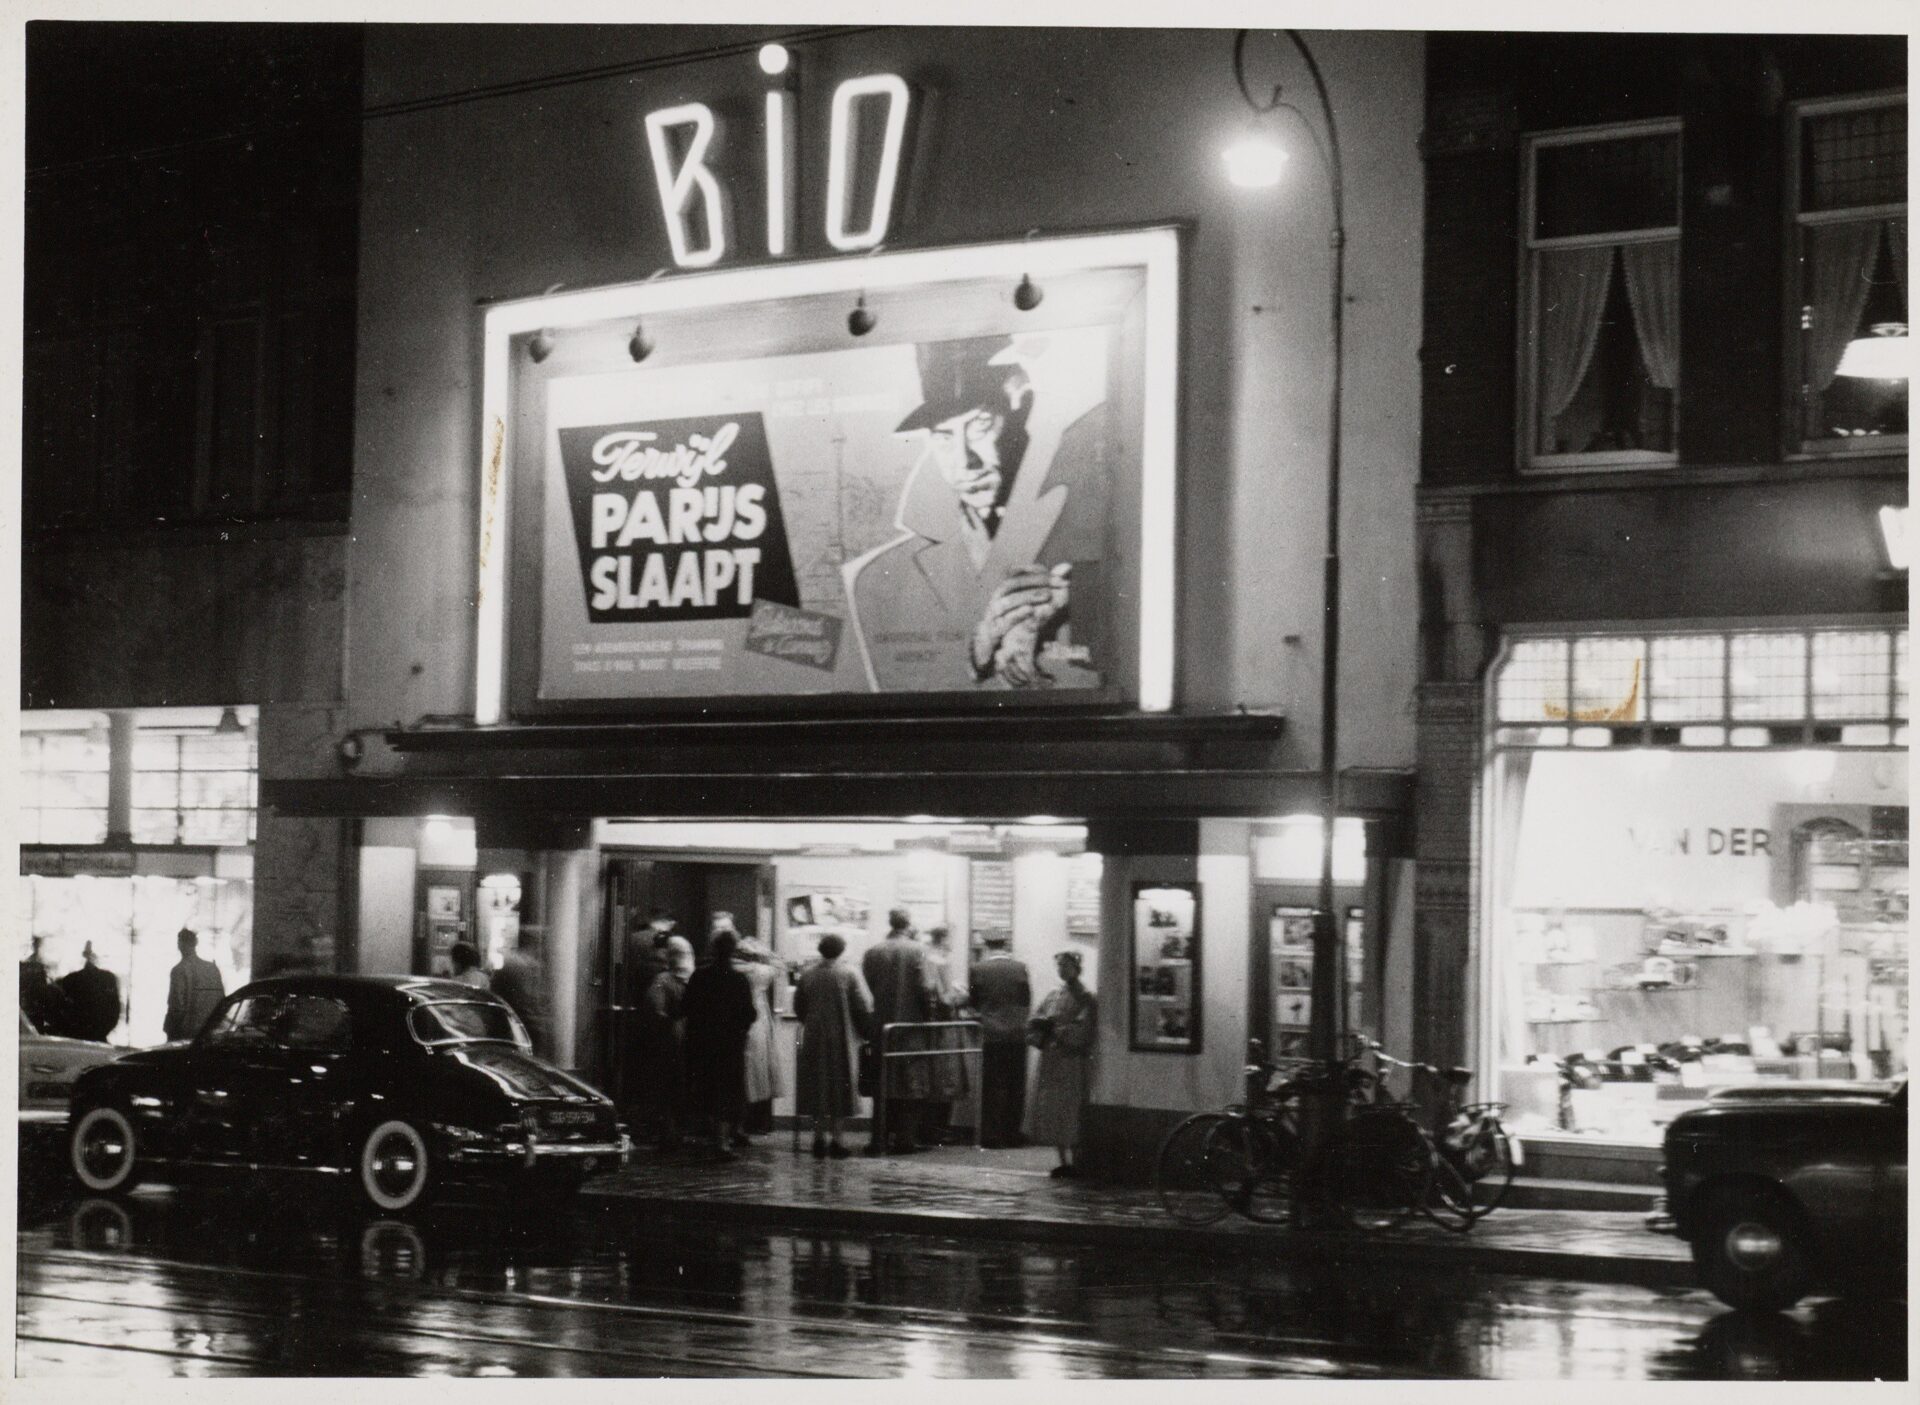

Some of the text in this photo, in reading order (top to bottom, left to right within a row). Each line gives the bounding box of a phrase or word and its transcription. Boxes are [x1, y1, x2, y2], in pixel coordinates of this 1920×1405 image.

[591, 483, 767, 548] PARIJS
[590, 547, 761, 610] SLAAPT
[1707, 828, 1772, 856] DER
